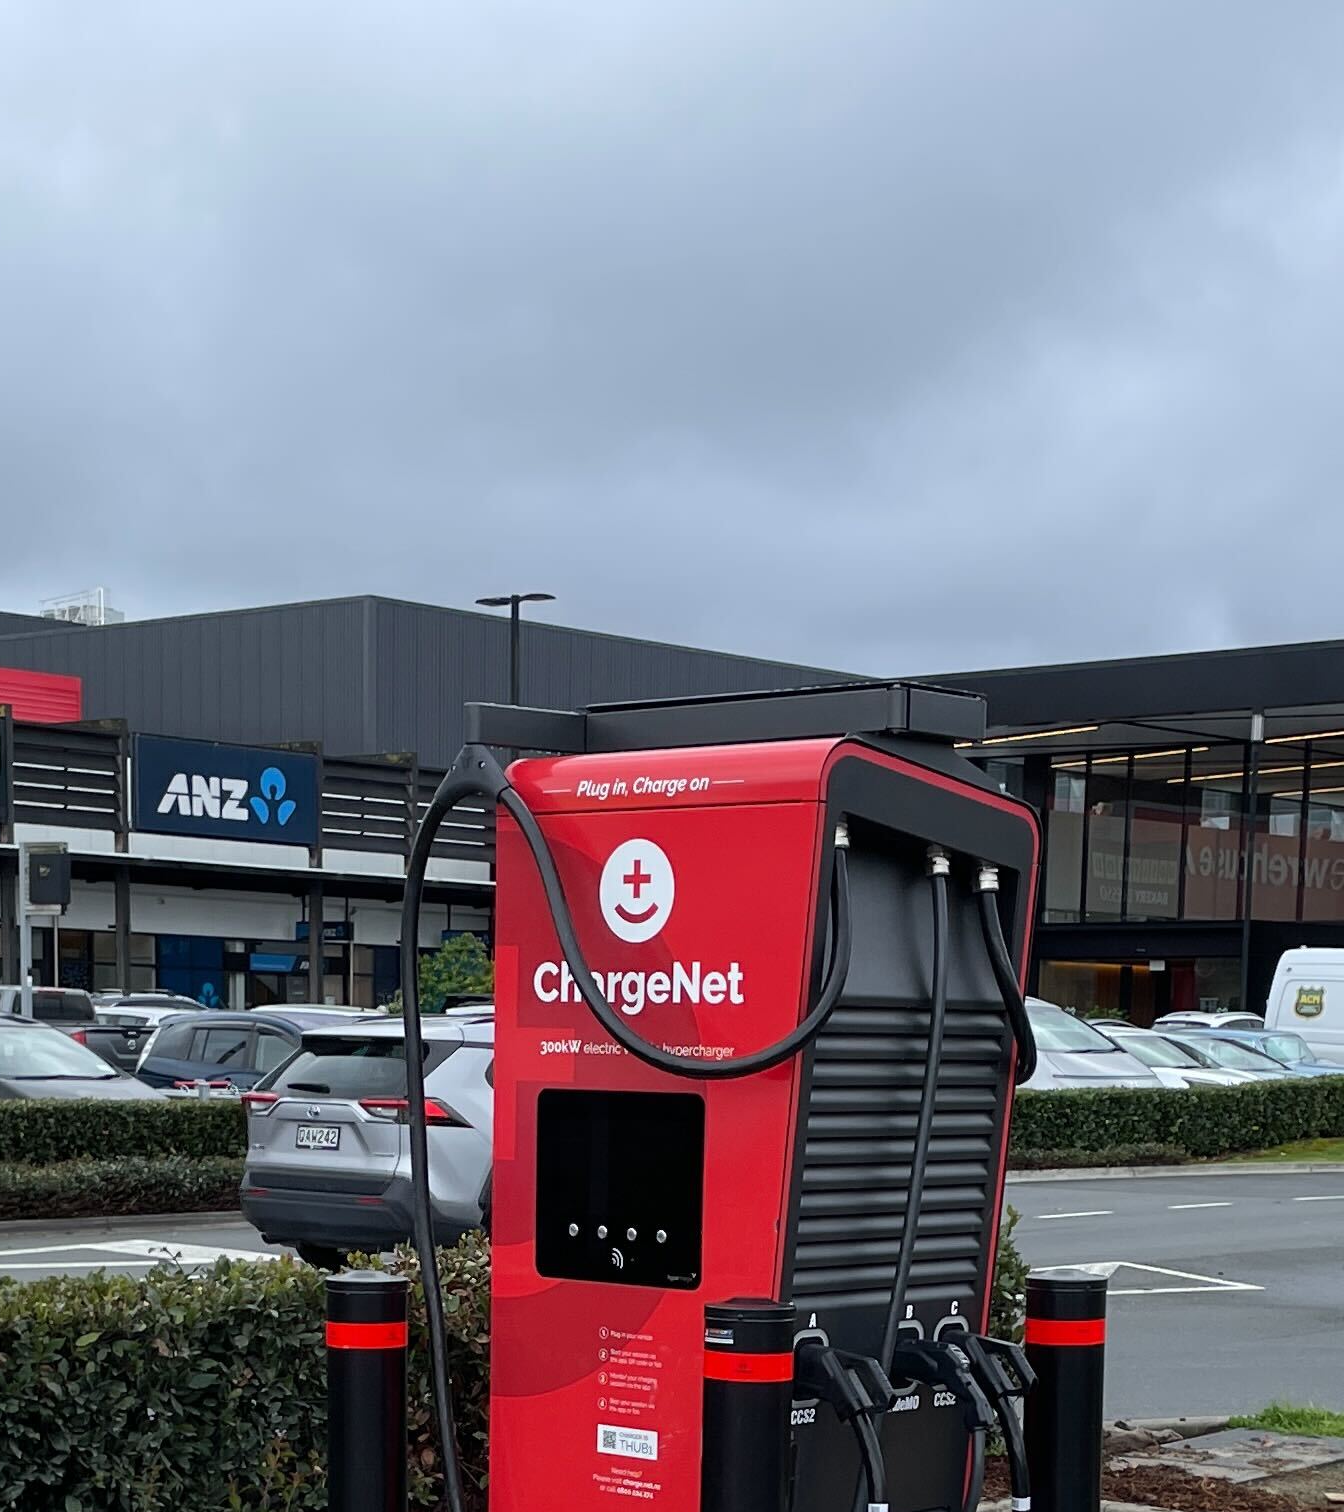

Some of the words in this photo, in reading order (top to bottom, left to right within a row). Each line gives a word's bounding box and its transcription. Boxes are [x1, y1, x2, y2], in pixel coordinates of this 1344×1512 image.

[577, 780, 610, 800] Plug
[612, 778, 628, 797] in,
[633, 777, 687, 796] Charge
[690, 777, 709, 790] on
[157, 773, 249, 821] ANZ
[540, 1040, 581, 1055] 300kW
[584, 1042, 621, 1055] electric
[662, 1042, 735, 1060] hypercharger
[905, 1304, 914, 1319] B
[950, 1300, 959, 1316] C
[809, 1312, 817, 1328] A
[934, 1392, 956, 1407] CCS2
[791, 1409, 815, 1425] CCS2
[619, 1439, 654, 1455] THUB1
